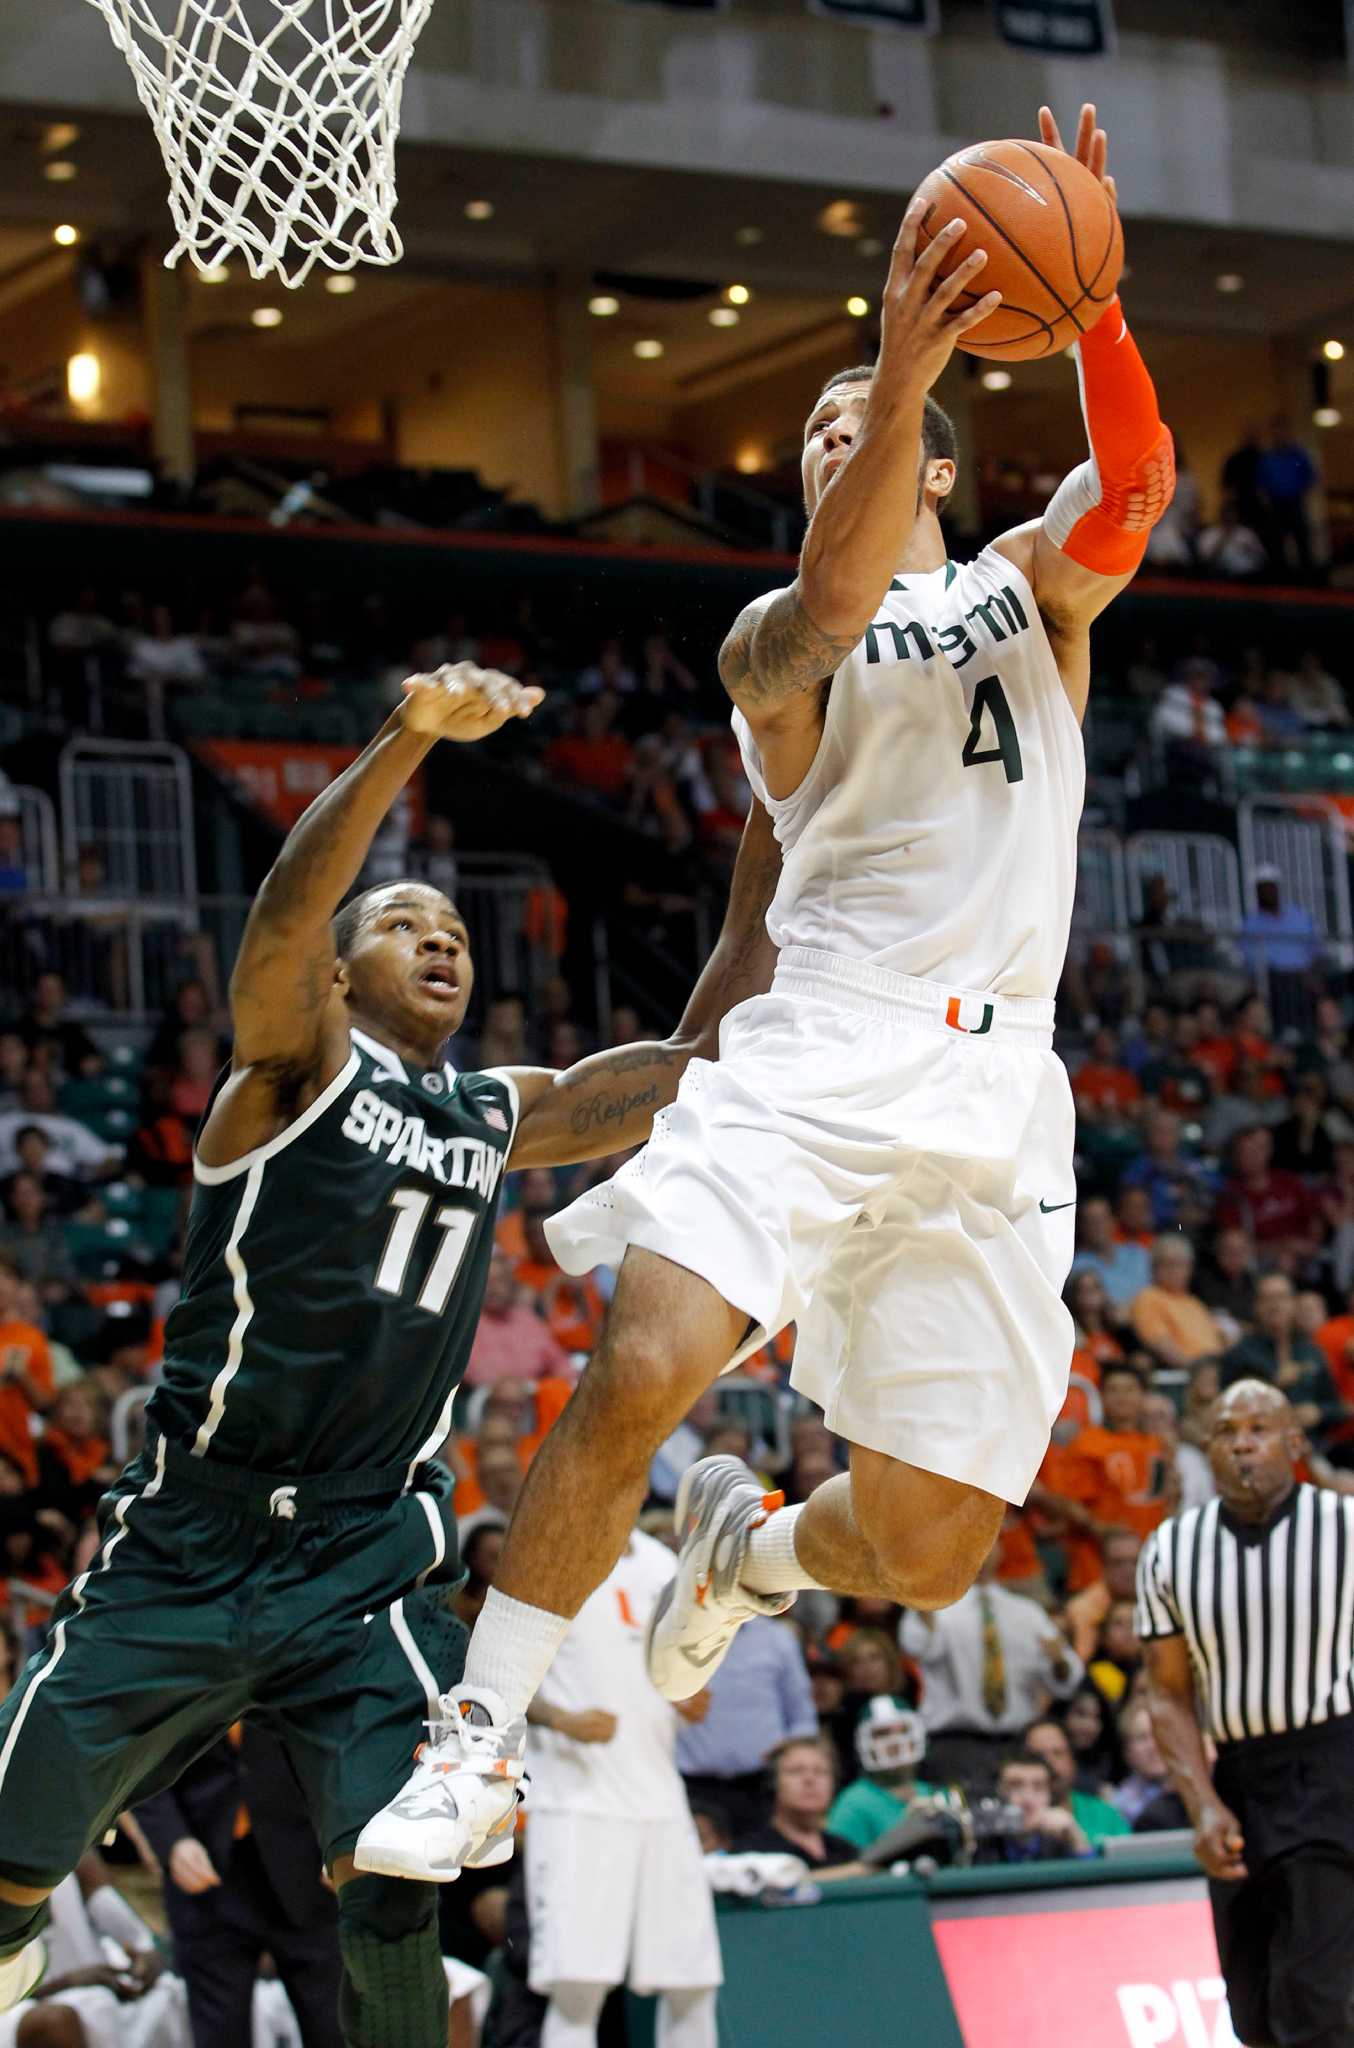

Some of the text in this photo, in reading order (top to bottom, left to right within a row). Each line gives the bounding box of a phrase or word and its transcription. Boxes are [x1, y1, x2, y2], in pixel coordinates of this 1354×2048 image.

[962, 674, 1023, 784] 4
[945, 996, 994, 1034] U
[570, 1083, 658, 1135] Respect
[374, 1187, 480, 1317] 11
